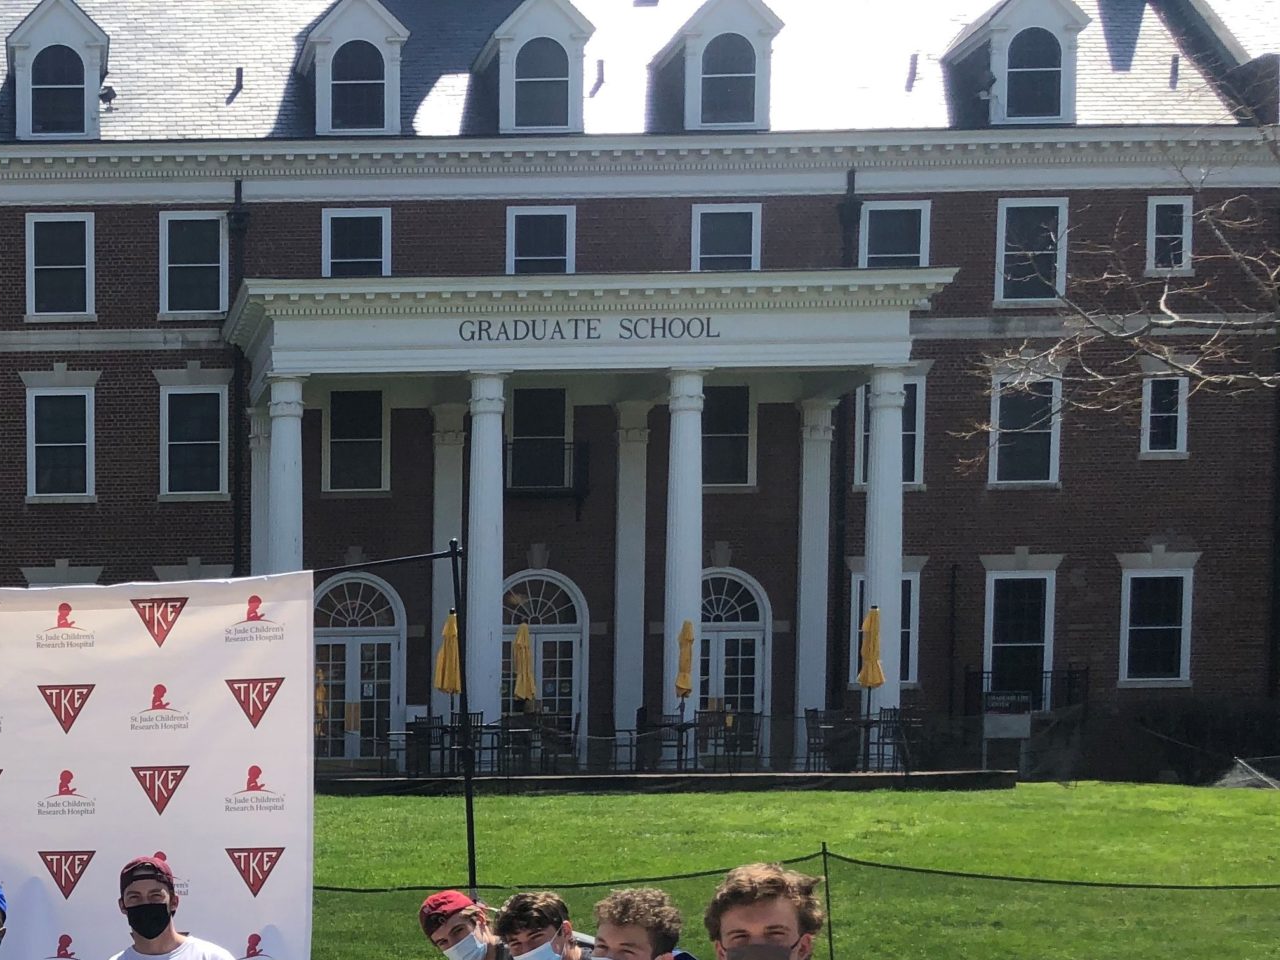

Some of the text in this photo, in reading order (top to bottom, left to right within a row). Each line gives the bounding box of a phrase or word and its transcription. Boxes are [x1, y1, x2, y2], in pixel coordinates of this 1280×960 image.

[459, 317, 720, 341] GRADUATE SCHOOL
[138, 602, 180, 635] TKE
[234, 628, 249, 636] Jude
[255, 634, 284, 642] Hospital
[45, 689, 88, 722] TKE
[233, 682, 277, 716] TKE
[130, 722, 189, 731] Research Hospital
[139, 715, 154, 723] Jude
[139, 771, 182, 803] TKE
[67, 808, 95, 817] Hospital
[225, 804, 285, 813] Research Hospital
[46, 856, 89, 888] TKE
[234, 852, 277, 885] TKE
